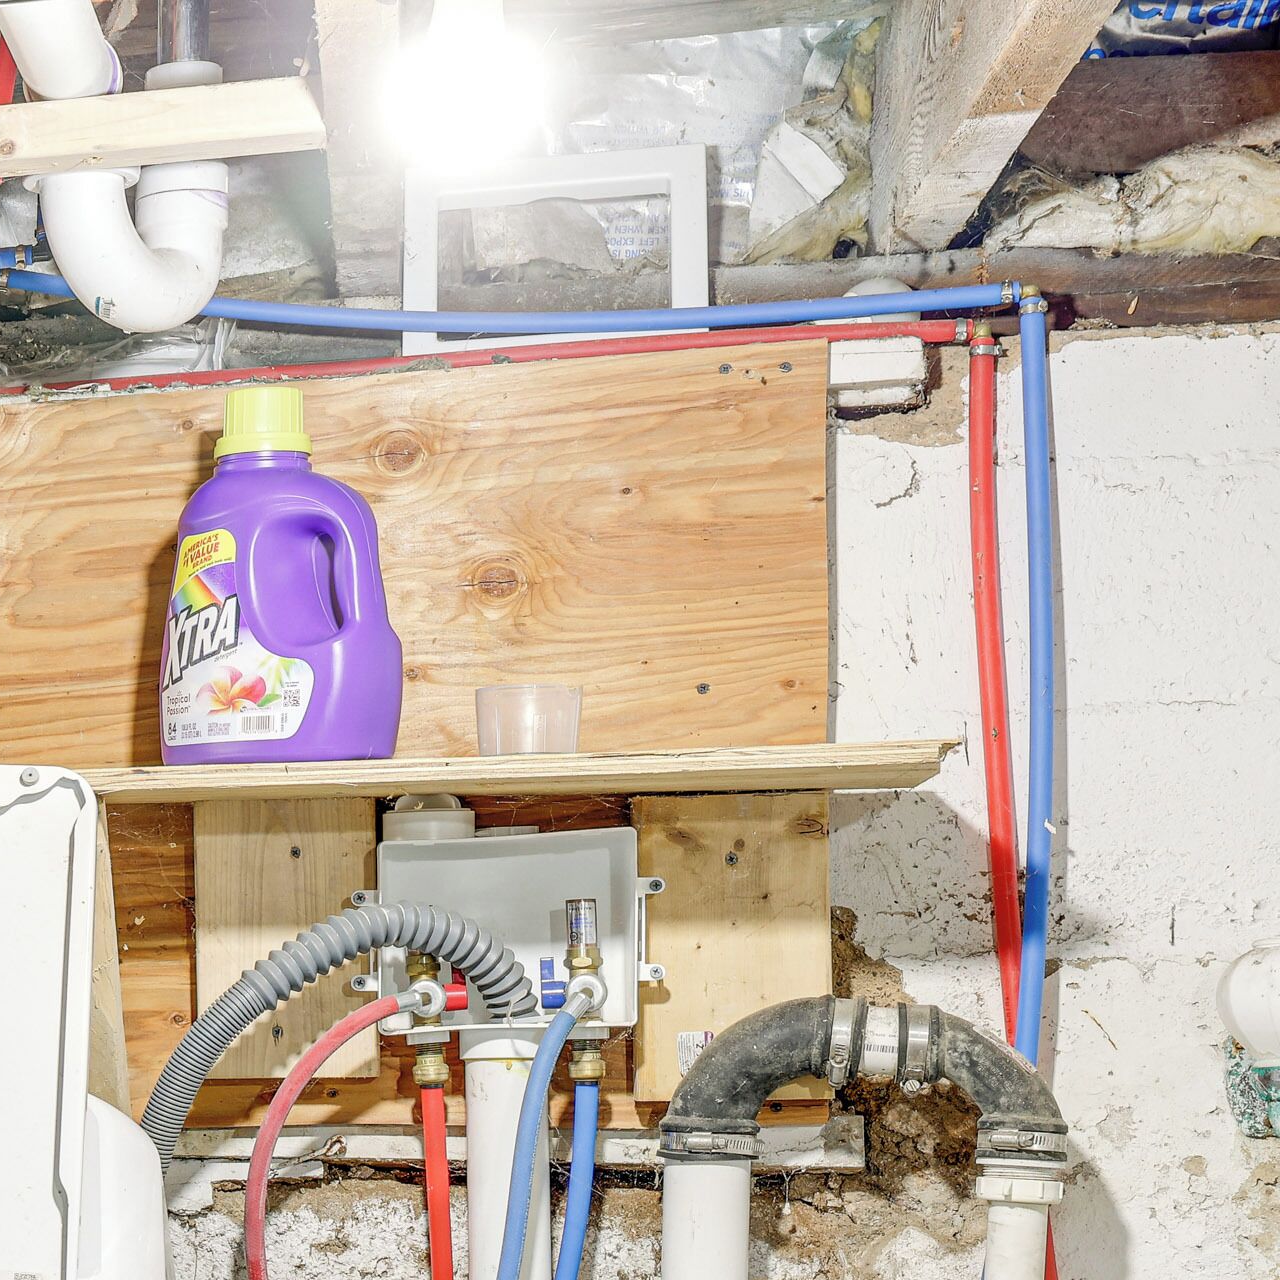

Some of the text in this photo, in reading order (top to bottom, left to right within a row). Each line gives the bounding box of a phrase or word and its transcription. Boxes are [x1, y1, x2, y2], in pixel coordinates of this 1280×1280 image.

[183, 533, 219, 559] AMERICA'S
[190, 542, 220, 563] VALUE
[162, 593, 241, 690] XTRA
[166, 693, 191, 706] Tropical
[166, 706, 190, 716] Passion
[167, 722, 177, 735] 84
